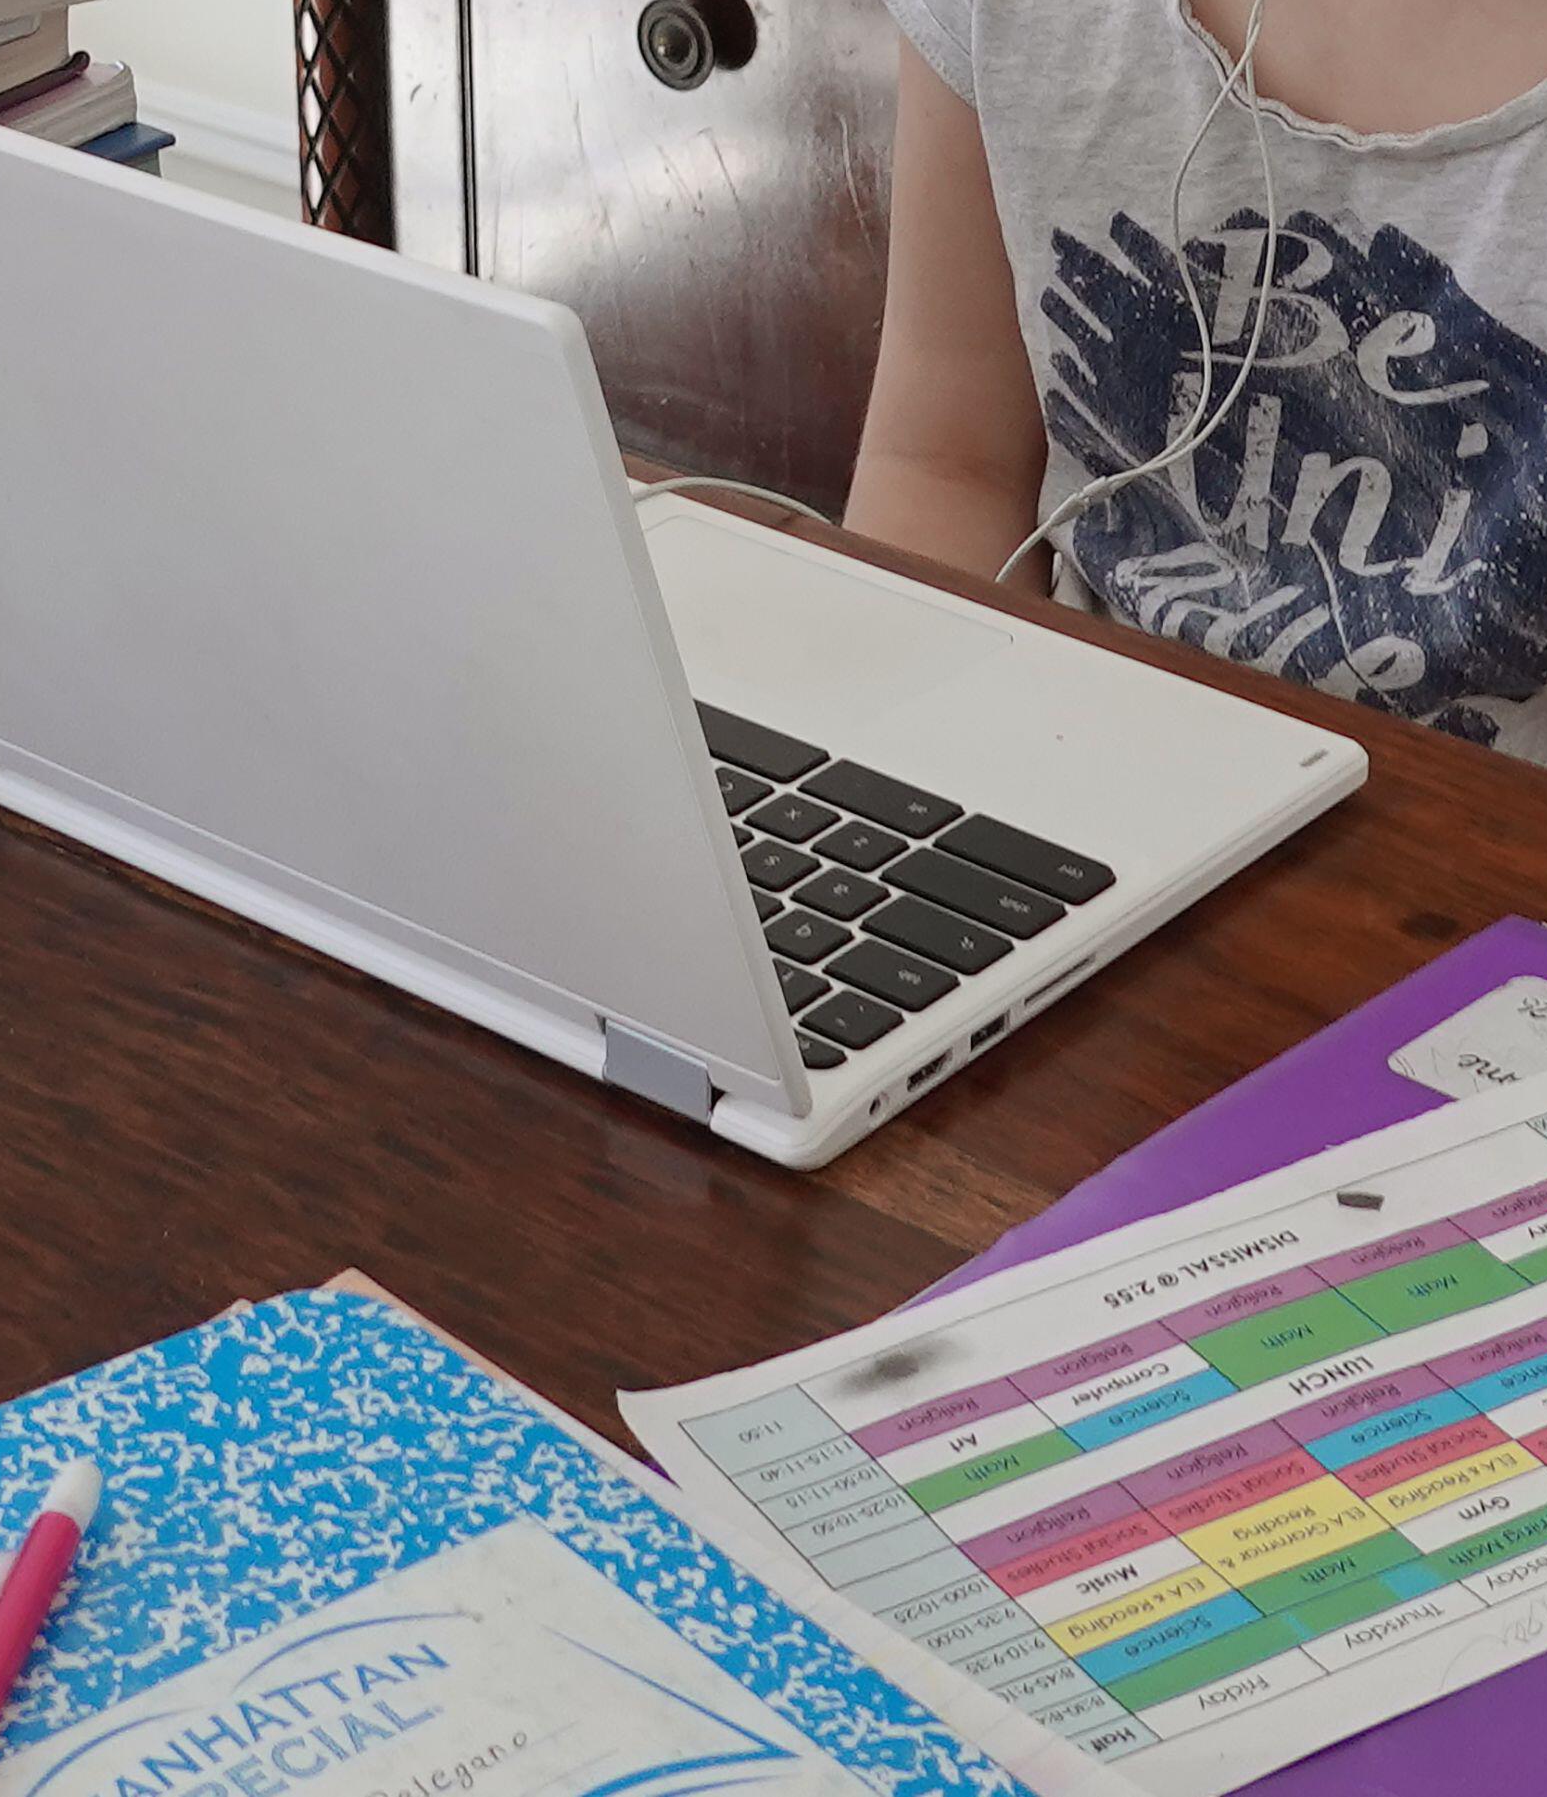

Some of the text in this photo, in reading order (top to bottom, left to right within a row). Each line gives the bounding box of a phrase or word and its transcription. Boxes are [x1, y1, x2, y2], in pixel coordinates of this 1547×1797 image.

[1179, 225, 1491, 406] Be
[1351, 1237, 1425, 1263] Religion
[1103, 1231, 1297, 1307] DISMISSAL @ 2:55
[1407, 1274, 1457, 1295] Math
[1206, 1285, 1282, 1315] Religion
[1261, 1325, 1313, 1346] Math
[1471, 1333, 1545, 1361] Religion
[1055, 1343, 1132, 1374] Religion
[1289, 1356, 1372, 1394] LUNCH
[1072, 1363, 1168, 1405] Computer
[1322, 1384, 1400, 1416] Religion
[899, 1398, 978, 1430] Religion
[1108, 1390, 1190, 1424] Science
[1351, 1409, 1431, 1442] Science
[950, 1433, 977, 1452] Art
[1355, 1428, 1487, 1481] Social Studies
[964, 1455, 1019, 1480] Math
[1168, 1444, 1247, 1478] Religion
[1483, 1453, 1517, 1471] ELA
[1169, 1461, 1304, 1518] Social Studies
[1388, 1472, 1469, 1507] Reading
[1233, 1506, 1315, 1539] Reading
[1459, 1496, 1509, 1519] Gym
[1007, 1507, 1090, 1542] Religion
[1007, 1525, 1147, 1580] Social Studies
[1240, 1523, 1329, 1560] Grammar
[1448, 1540, 1504, 1563] Math
[1078, 1565, 1137, 1592] Music
[1302, 1558, 1355, 1582] Math
[1168, 1578, 1205, 1597] ELA
[1068, 1601, 1153, 1638] Reading
[1124, 1616, 1211, 1655] Science
[1344, 1604, 1441, 1647] Thursday
[1198, 1676, 1268, 1708] Friday
[93, 1644, 450, 1797] ANHATTAN
